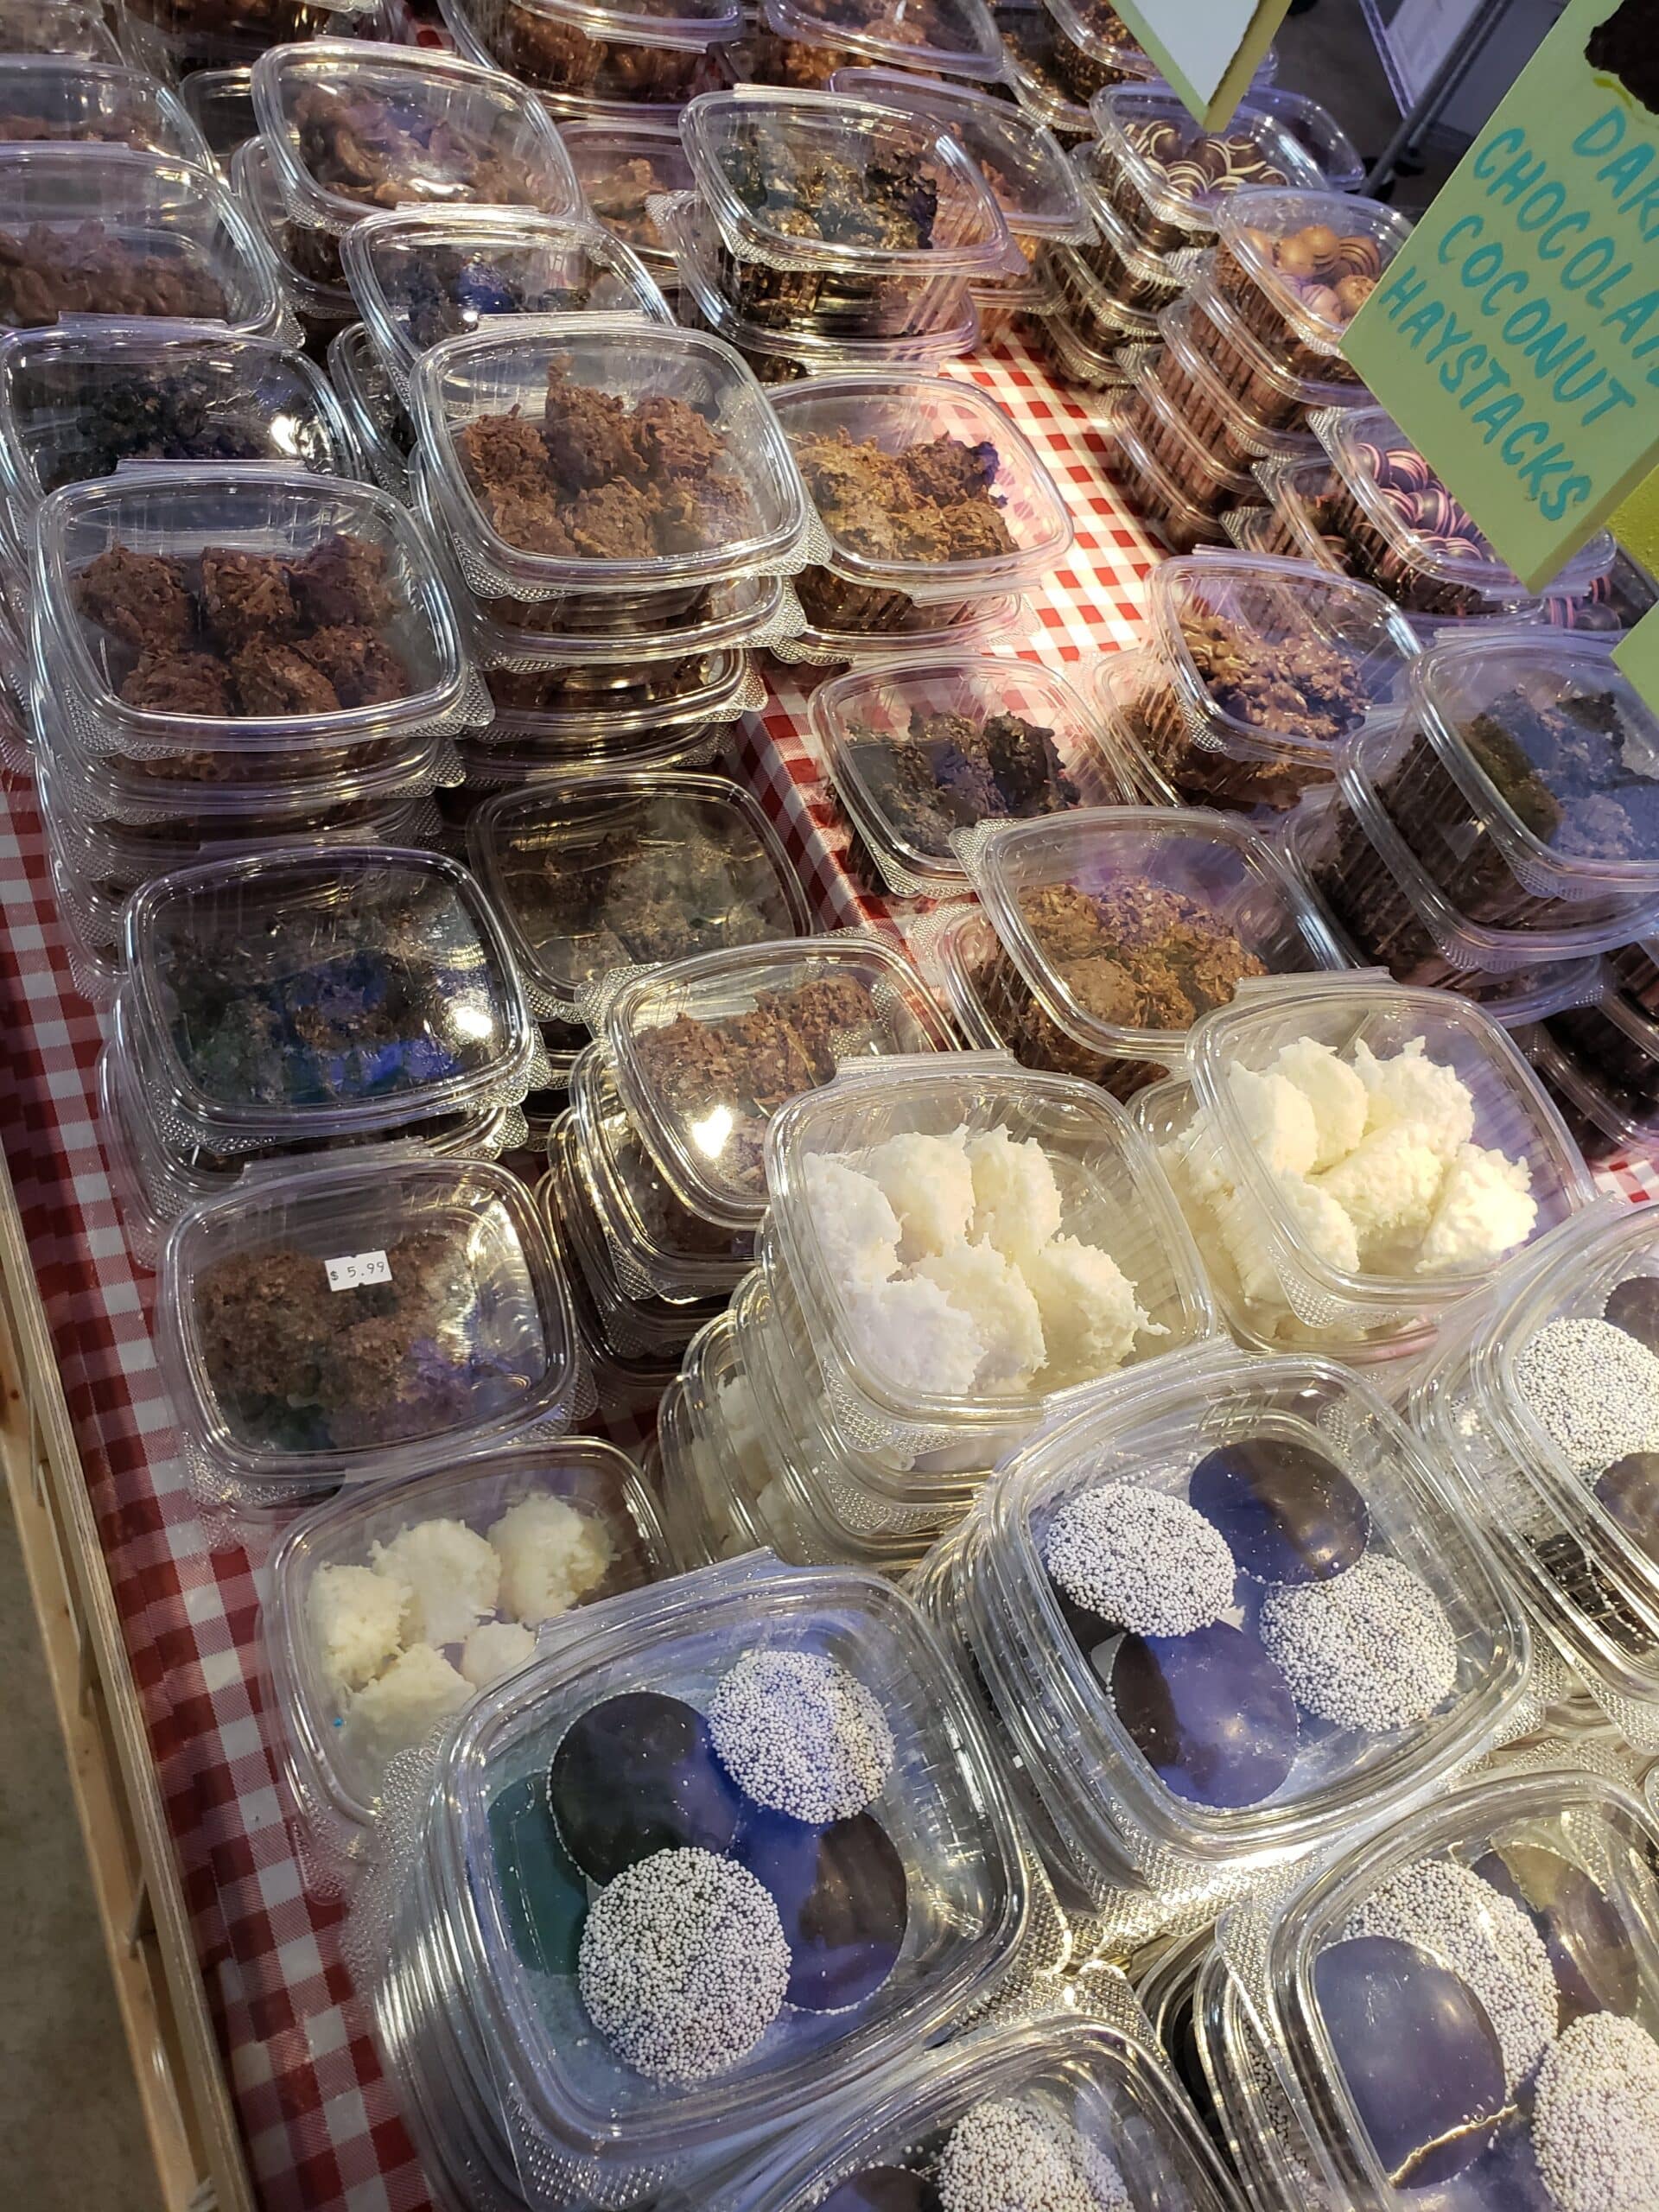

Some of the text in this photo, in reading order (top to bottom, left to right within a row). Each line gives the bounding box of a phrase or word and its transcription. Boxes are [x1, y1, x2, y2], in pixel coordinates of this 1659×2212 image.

[1439, 215, 1635, 426] COCONUT
[1473, 128, 1659, 387] CHOCOLA
[1380, 266, 1591, 521] HAYSTACKS
